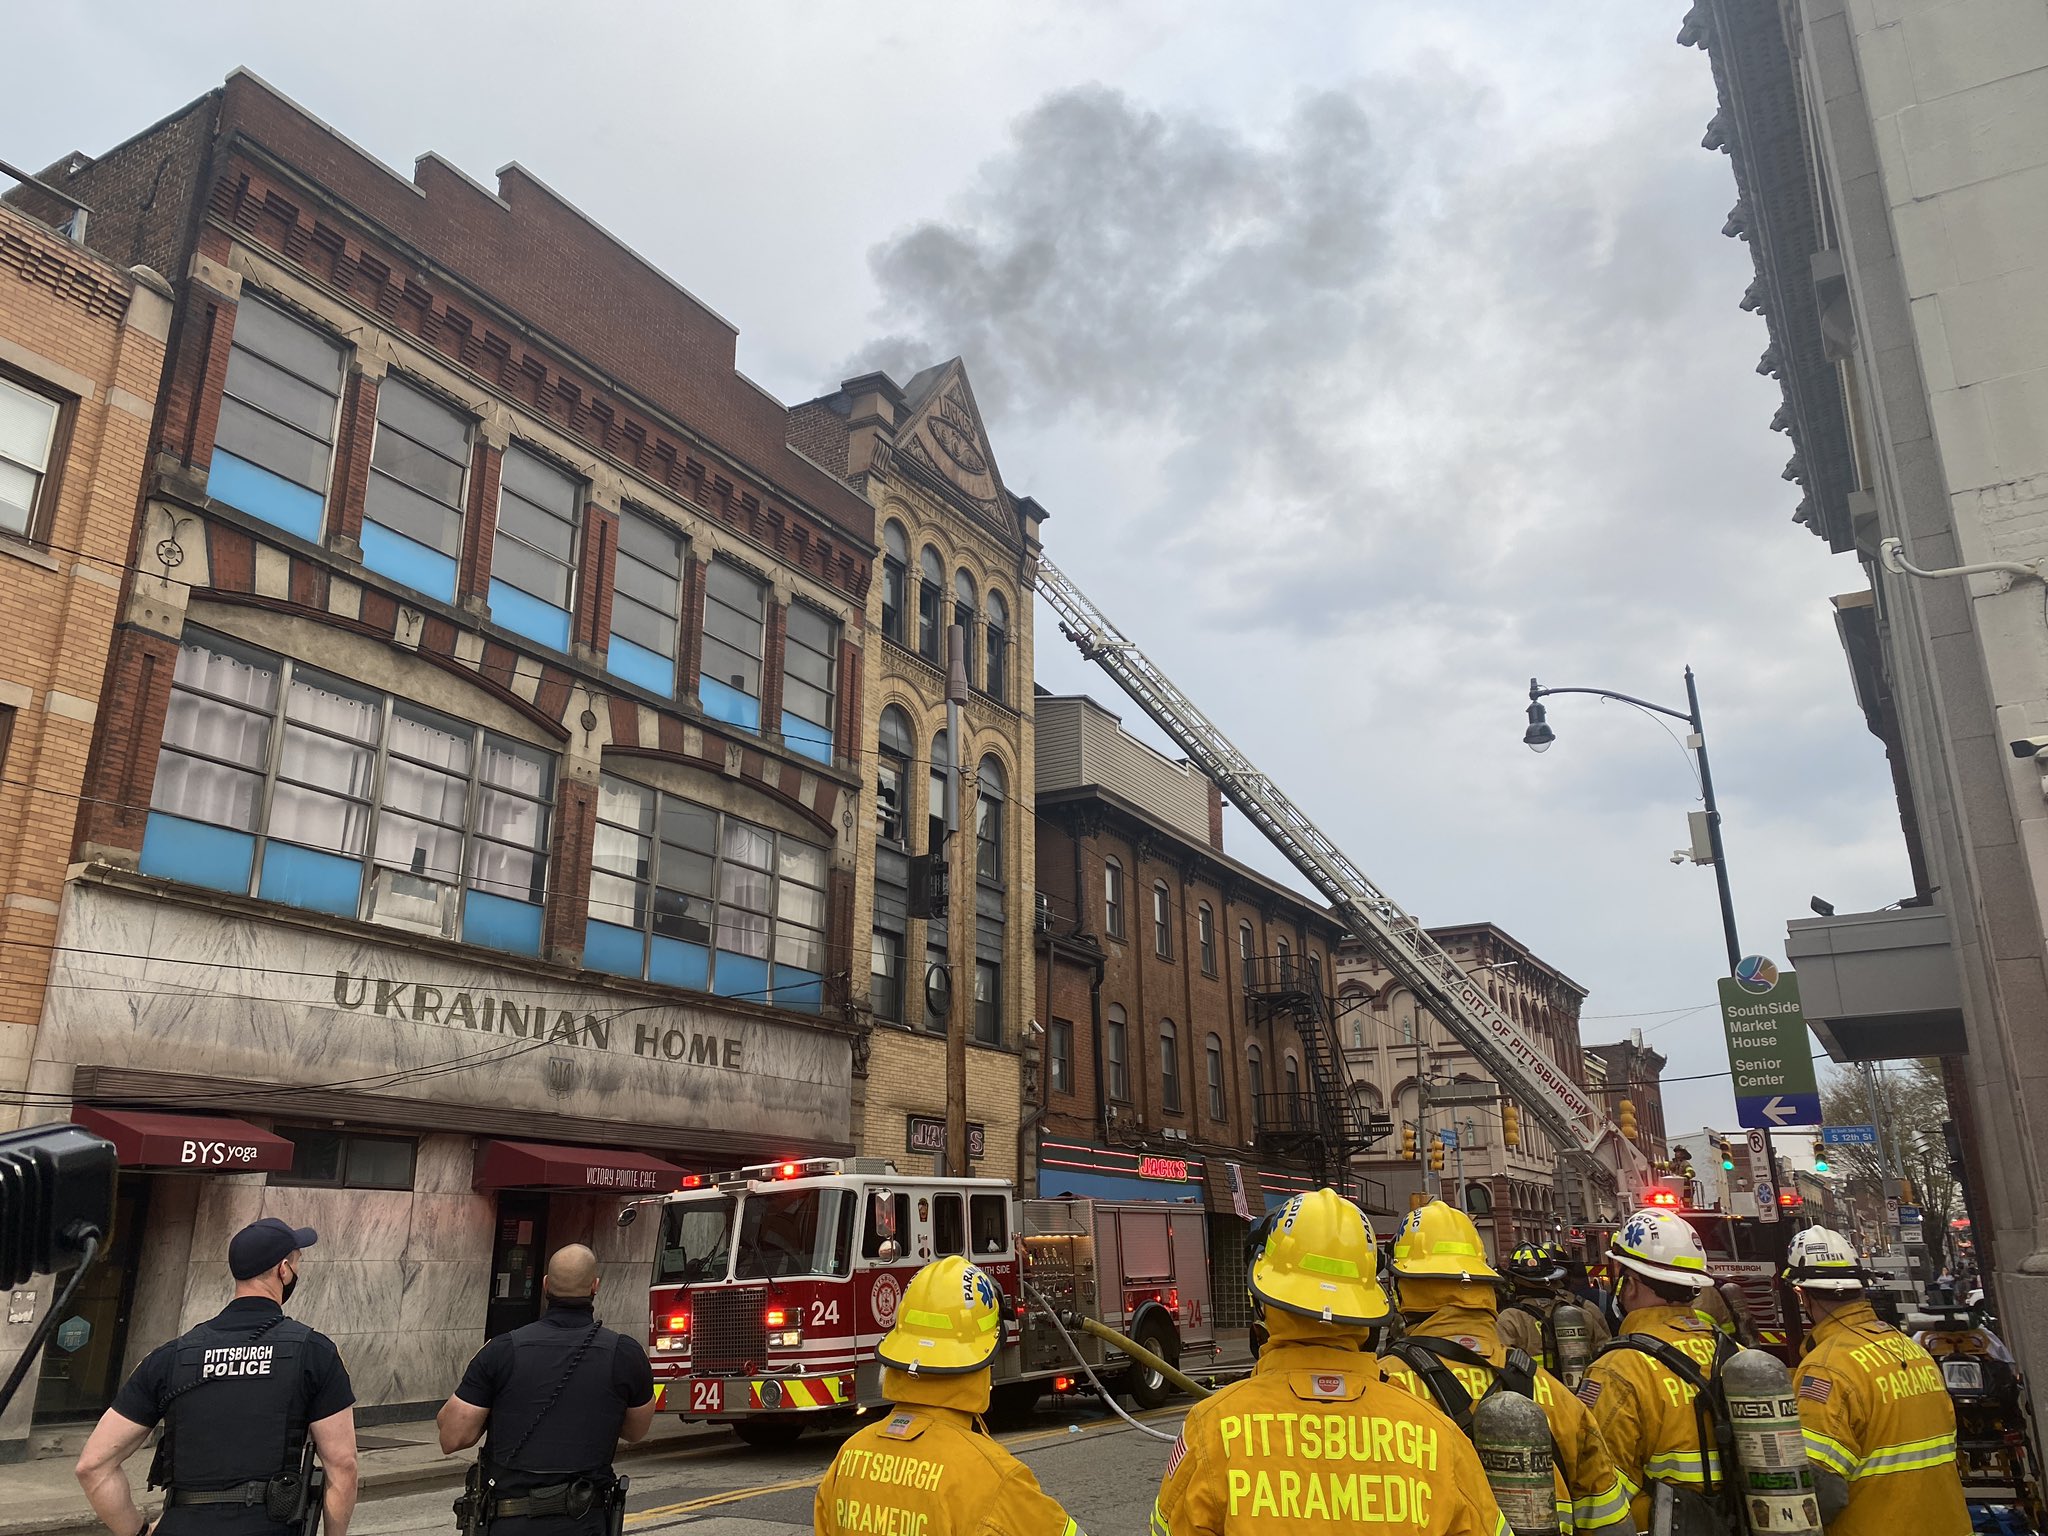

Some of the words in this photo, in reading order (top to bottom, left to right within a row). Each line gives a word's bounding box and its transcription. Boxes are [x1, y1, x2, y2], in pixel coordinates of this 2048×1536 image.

[333, 970, 611, 1050] UKRAINIAN
[634, 1023, 743, 1069] HOME
[1730, 1019, 1777, 1033] Market
[1462, 989, 1491, 1018] CITY
[1492, 1020, 1511, 1037] OF
[1510, 1038, 1585, 1115] PITTSBURGH
[1732, 1036, 1777, 1049] House
[1736, 1059, 1782, 1071] Senior
[1738, 1075, 1784, 1087] Center
[1832, 1134, 1838, 1142] S
[1842, 1133, 1860, 1141] 12th
[1862, 1133, 1873, 1141] St
[181, 1140, 225, 1165] BYS
[226, 1145, 258, 1162] yoga
[586, 1167, 614, 1186] VICTORY
[615, 1169, 638, 1187] POINTE
[996, 1265, 1011, 1275] SIDE
[811, 1300, 840, 1326] 24
[879, 1317, 894, 1325] FIRE
[1187, 1299, 1203, 1329] 24
[203, 1345, 274, 1364] PITTSBURGH
[202, 1360, 272, 1378] POLICE
[693, 1382, 720, 1411] 24
[1732, 1403, 1773, 1417] MSA
[1220, 1413, 1438, 1472] PITTSBURGH
[837, 1449, 944, 1492] PITTSBURGH
[1228, 1469, 1432, 1529] PARAMEDIC
[836, 1498, 929, 1536] PARAMEDIC
